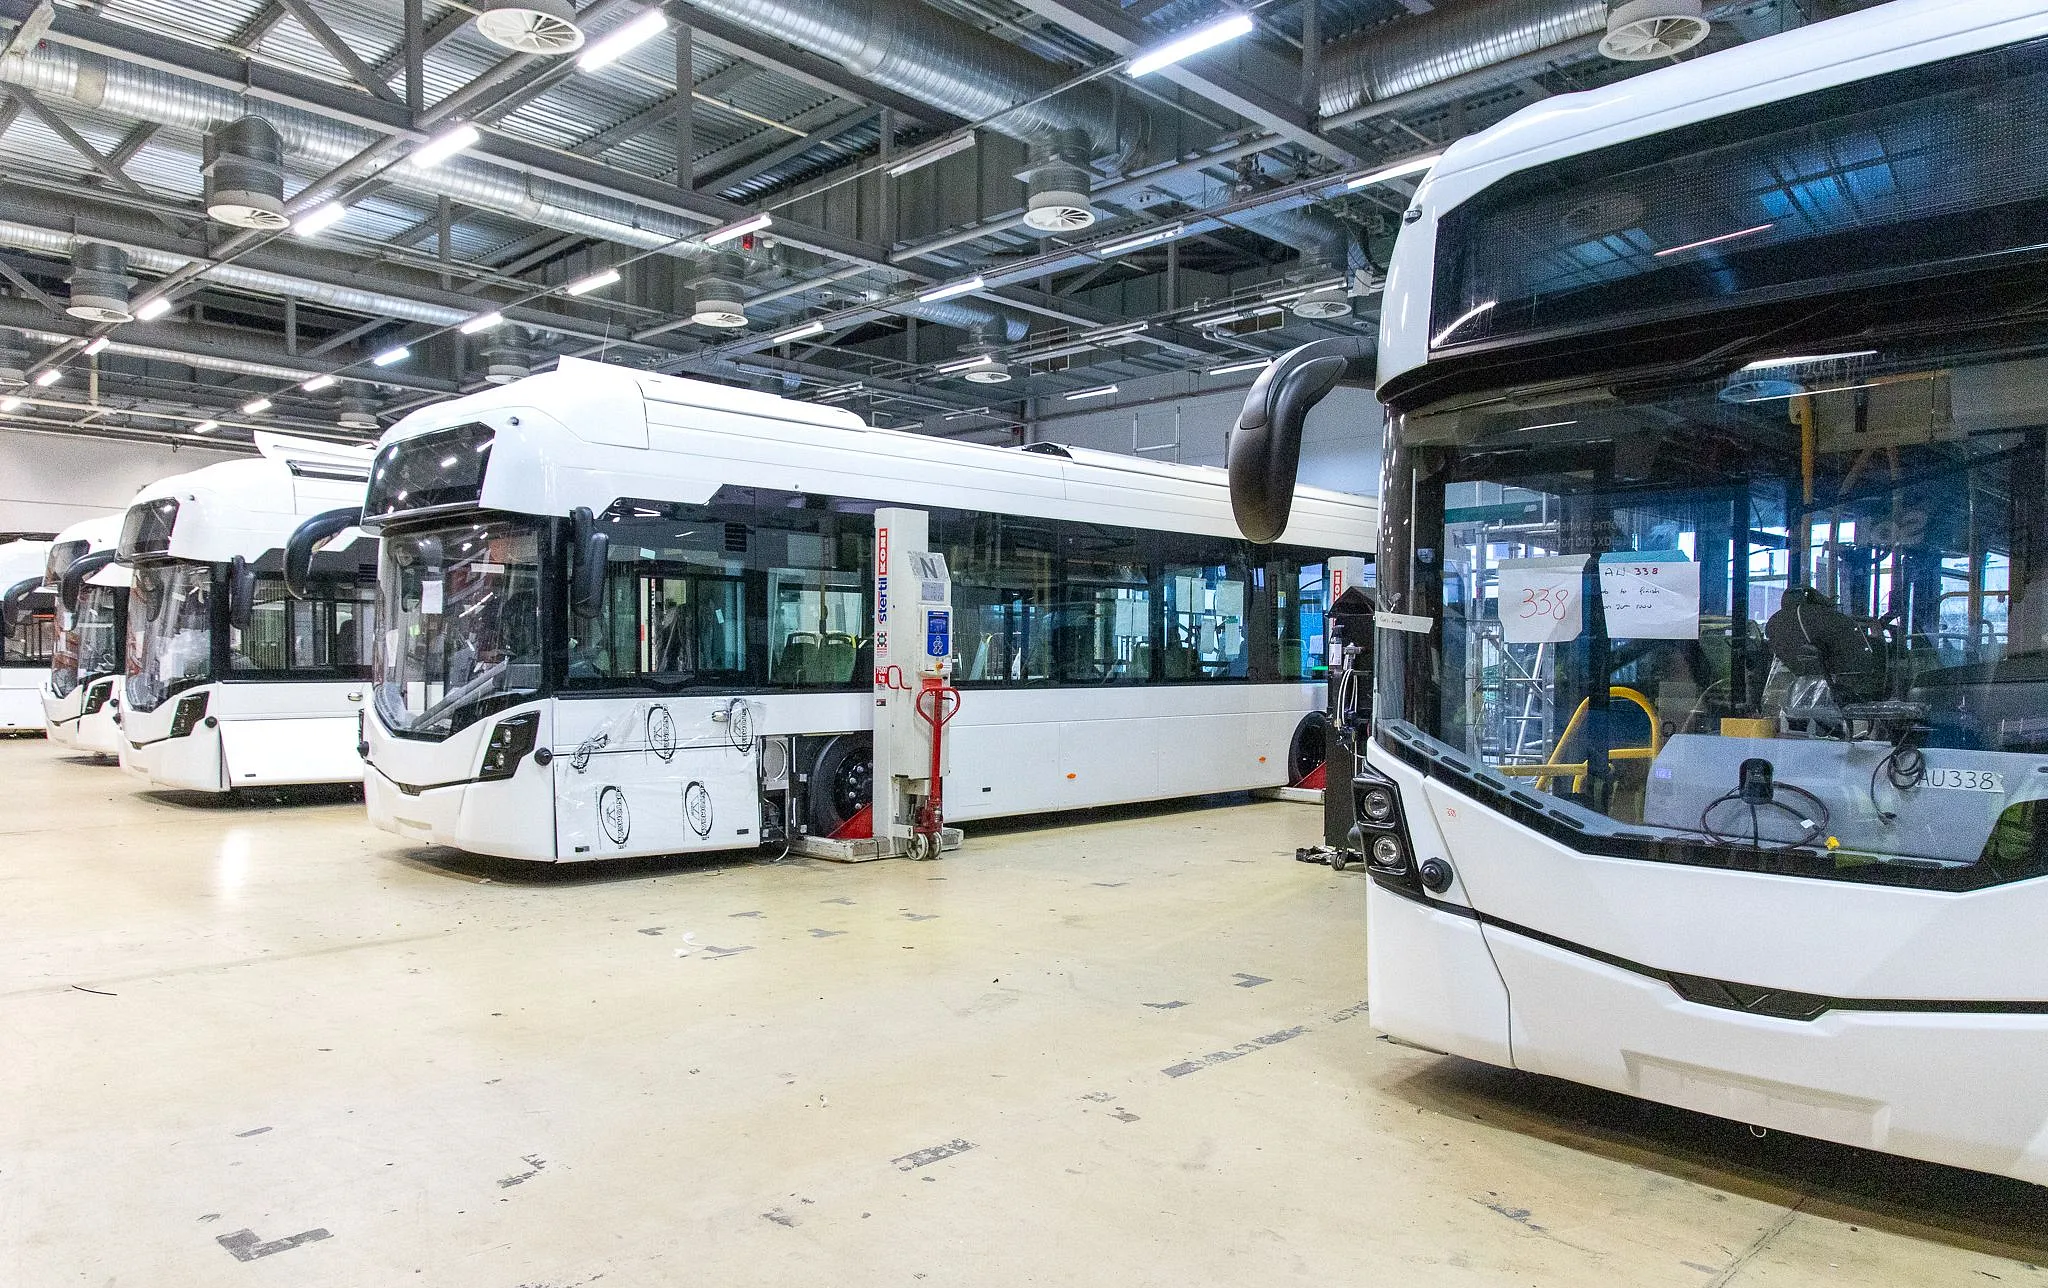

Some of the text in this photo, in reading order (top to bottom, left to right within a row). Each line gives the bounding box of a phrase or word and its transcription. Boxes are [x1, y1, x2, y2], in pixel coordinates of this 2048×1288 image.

[919, 557, 938, 579] N
[1634, 567, 1658, 576] 338
[878, 577, 887, 623] stertil
[1519, 588, 1568, 620] 338
[1918, 770, 1994, 790] AU338
